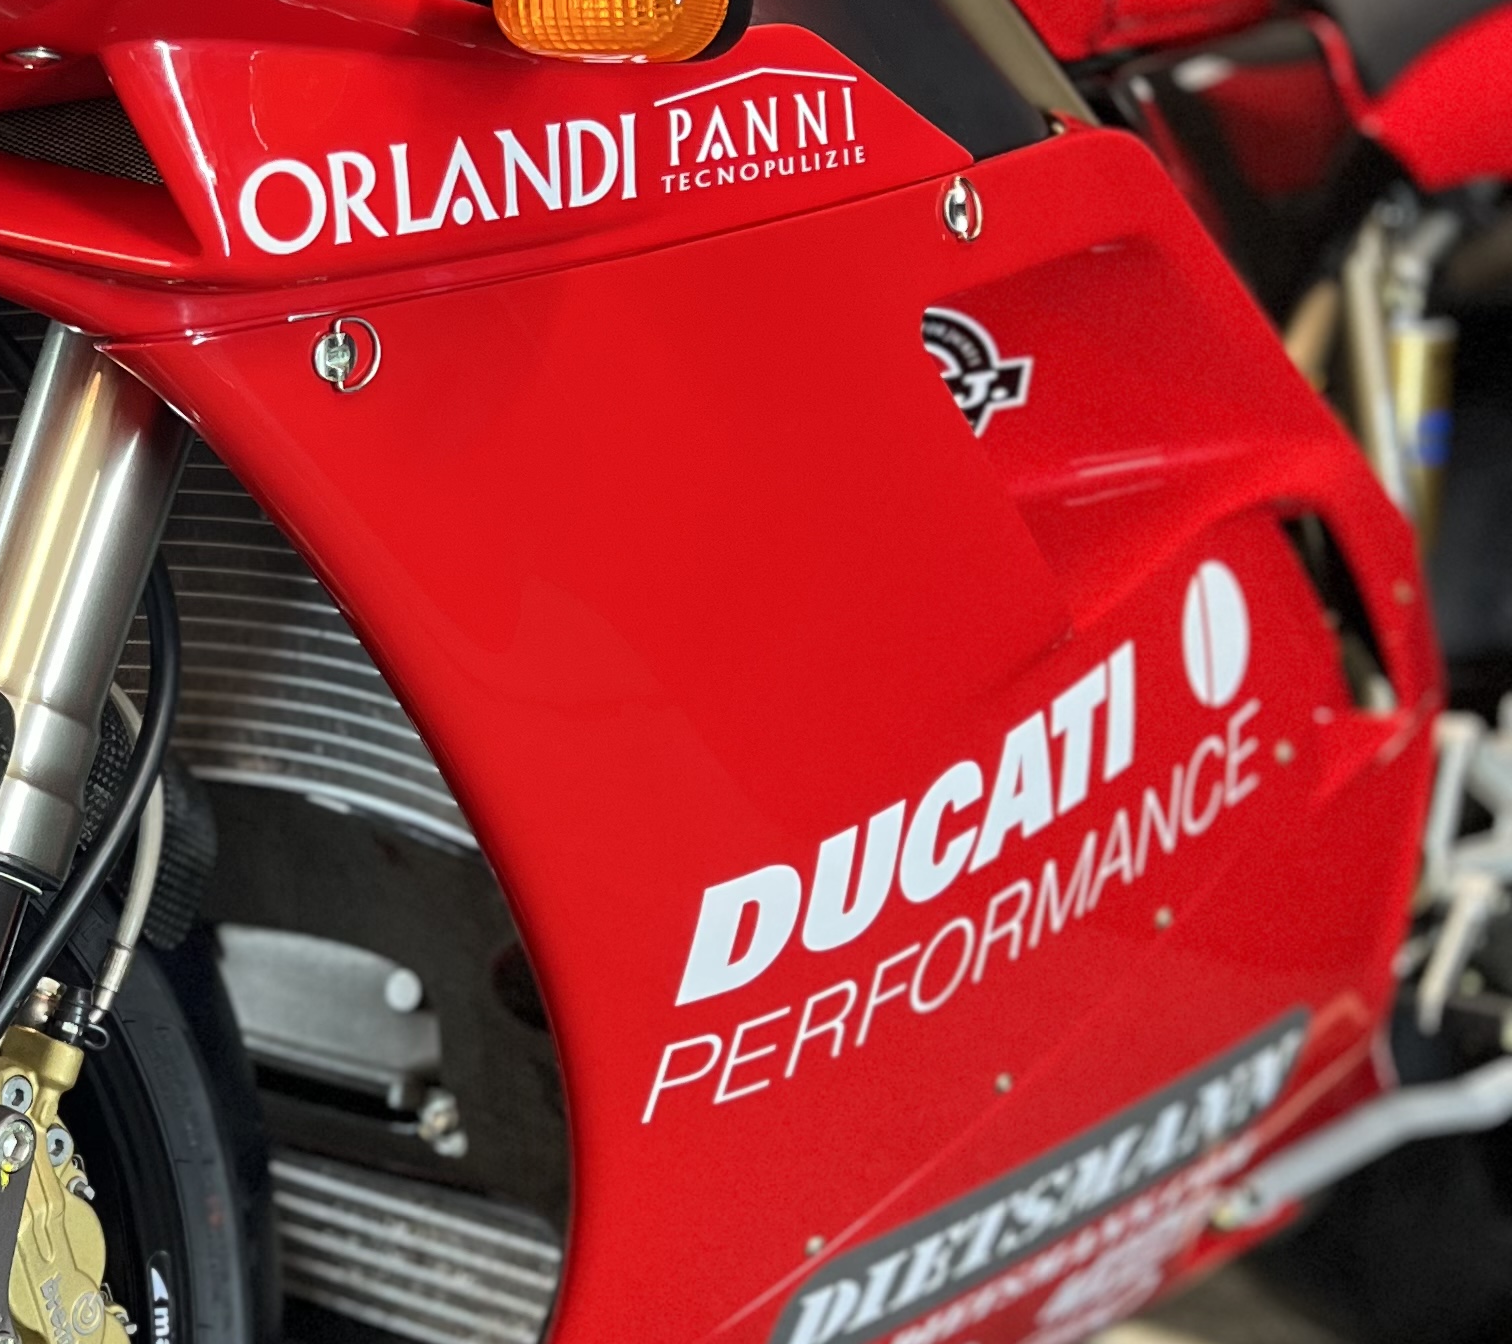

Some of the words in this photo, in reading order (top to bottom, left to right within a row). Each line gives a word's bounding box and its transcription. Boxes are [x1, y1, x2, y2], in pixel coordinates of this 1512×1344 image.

[239, 112, 636, 255] ORLANDI
[669, 86, 858, 166] PANNI
[661, 144, 867, 194] TECNOPULIZIE
[641, 698, 1260, 1125] PERFORMANCE
[674, 639, 1134, 1006] DUCATI
